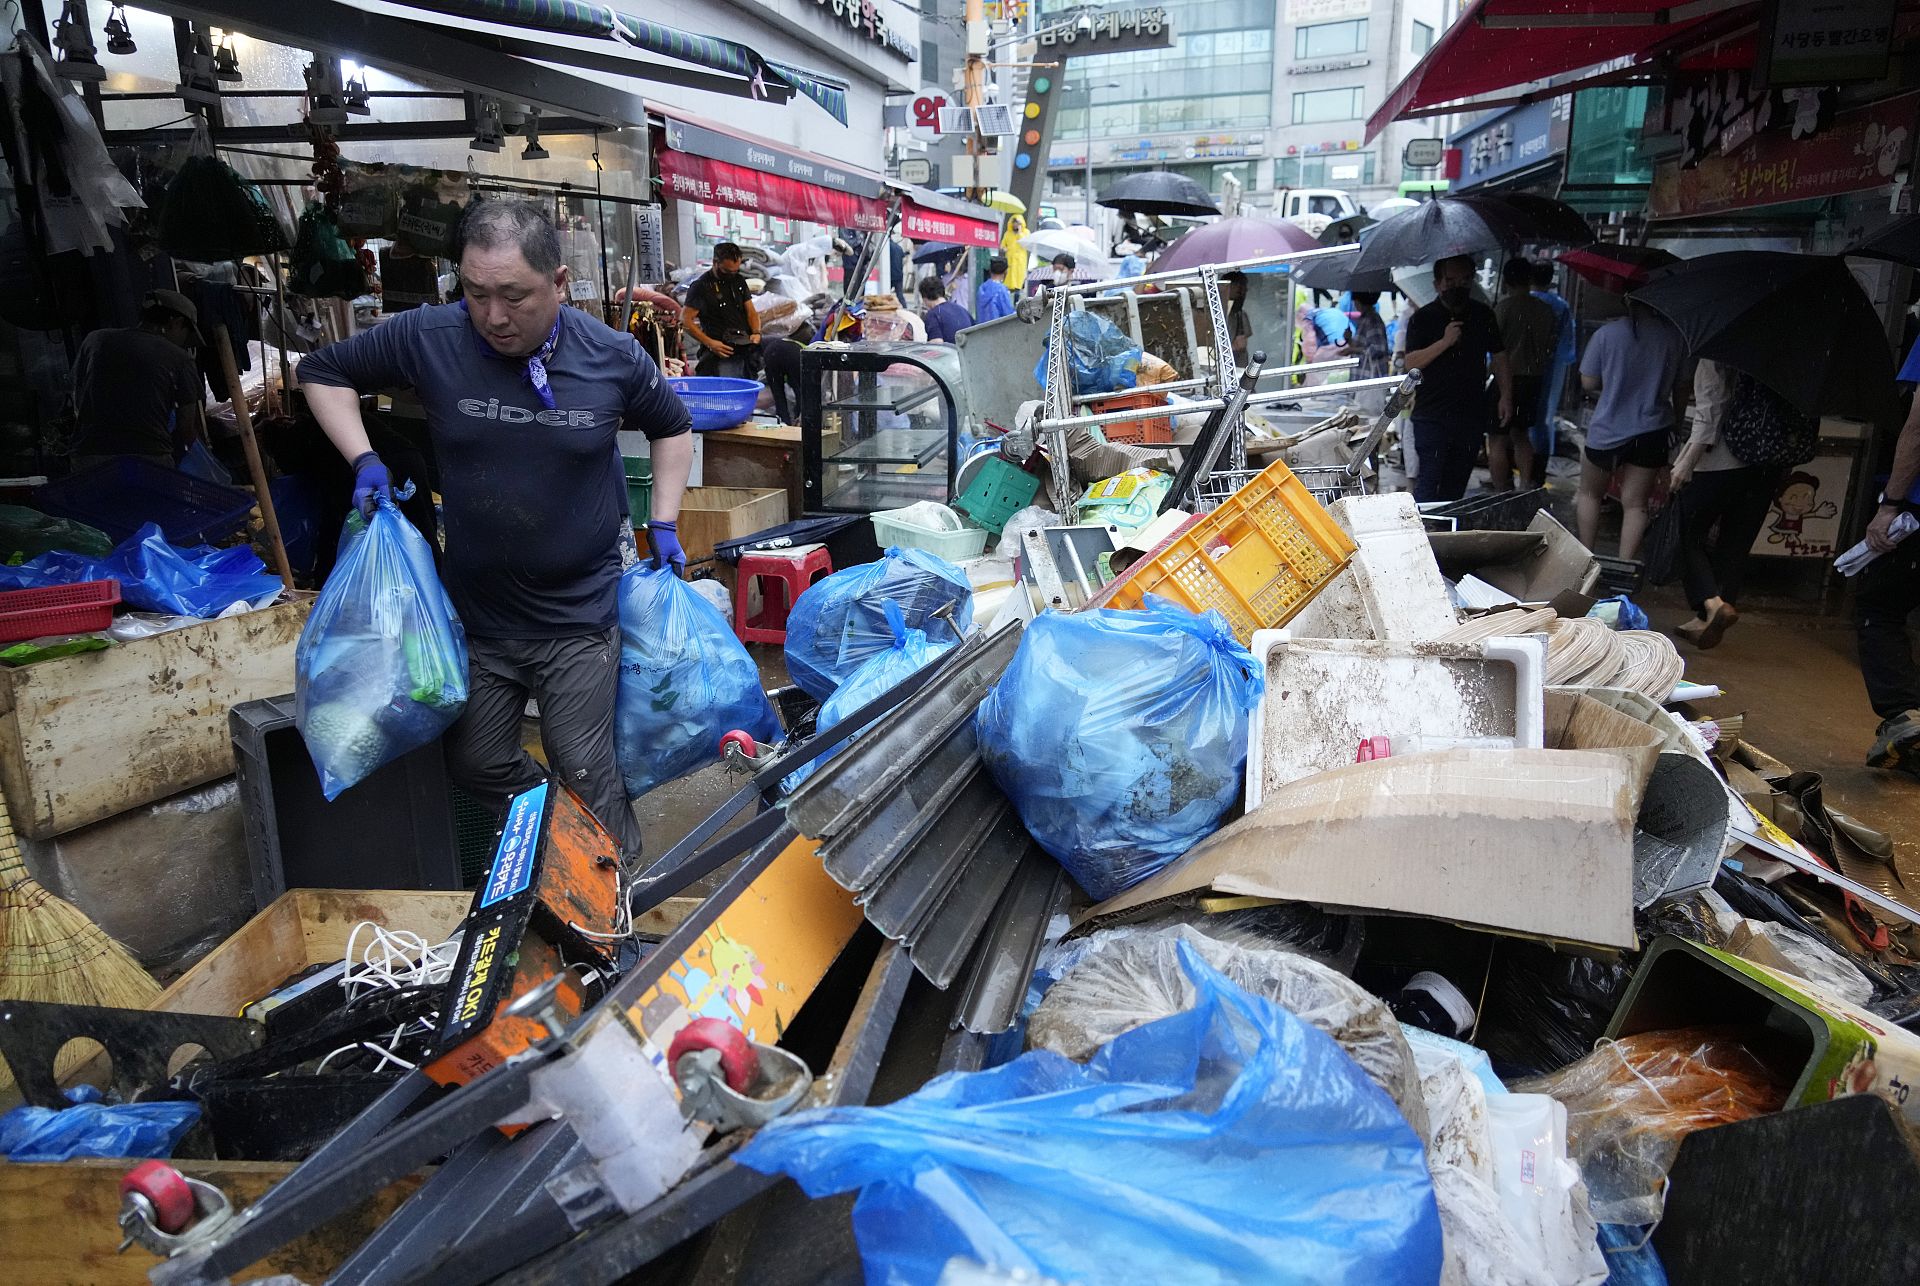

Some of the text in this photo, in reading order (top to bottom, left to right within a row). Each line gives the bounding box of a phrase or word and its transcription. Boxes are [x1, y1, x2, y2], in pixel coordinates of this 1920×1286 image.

[913, 96, 945, 134] 약
[490, 851, 516, 900] 우리카드
[460, 926, 502, 1022] 카드결제 OK!
